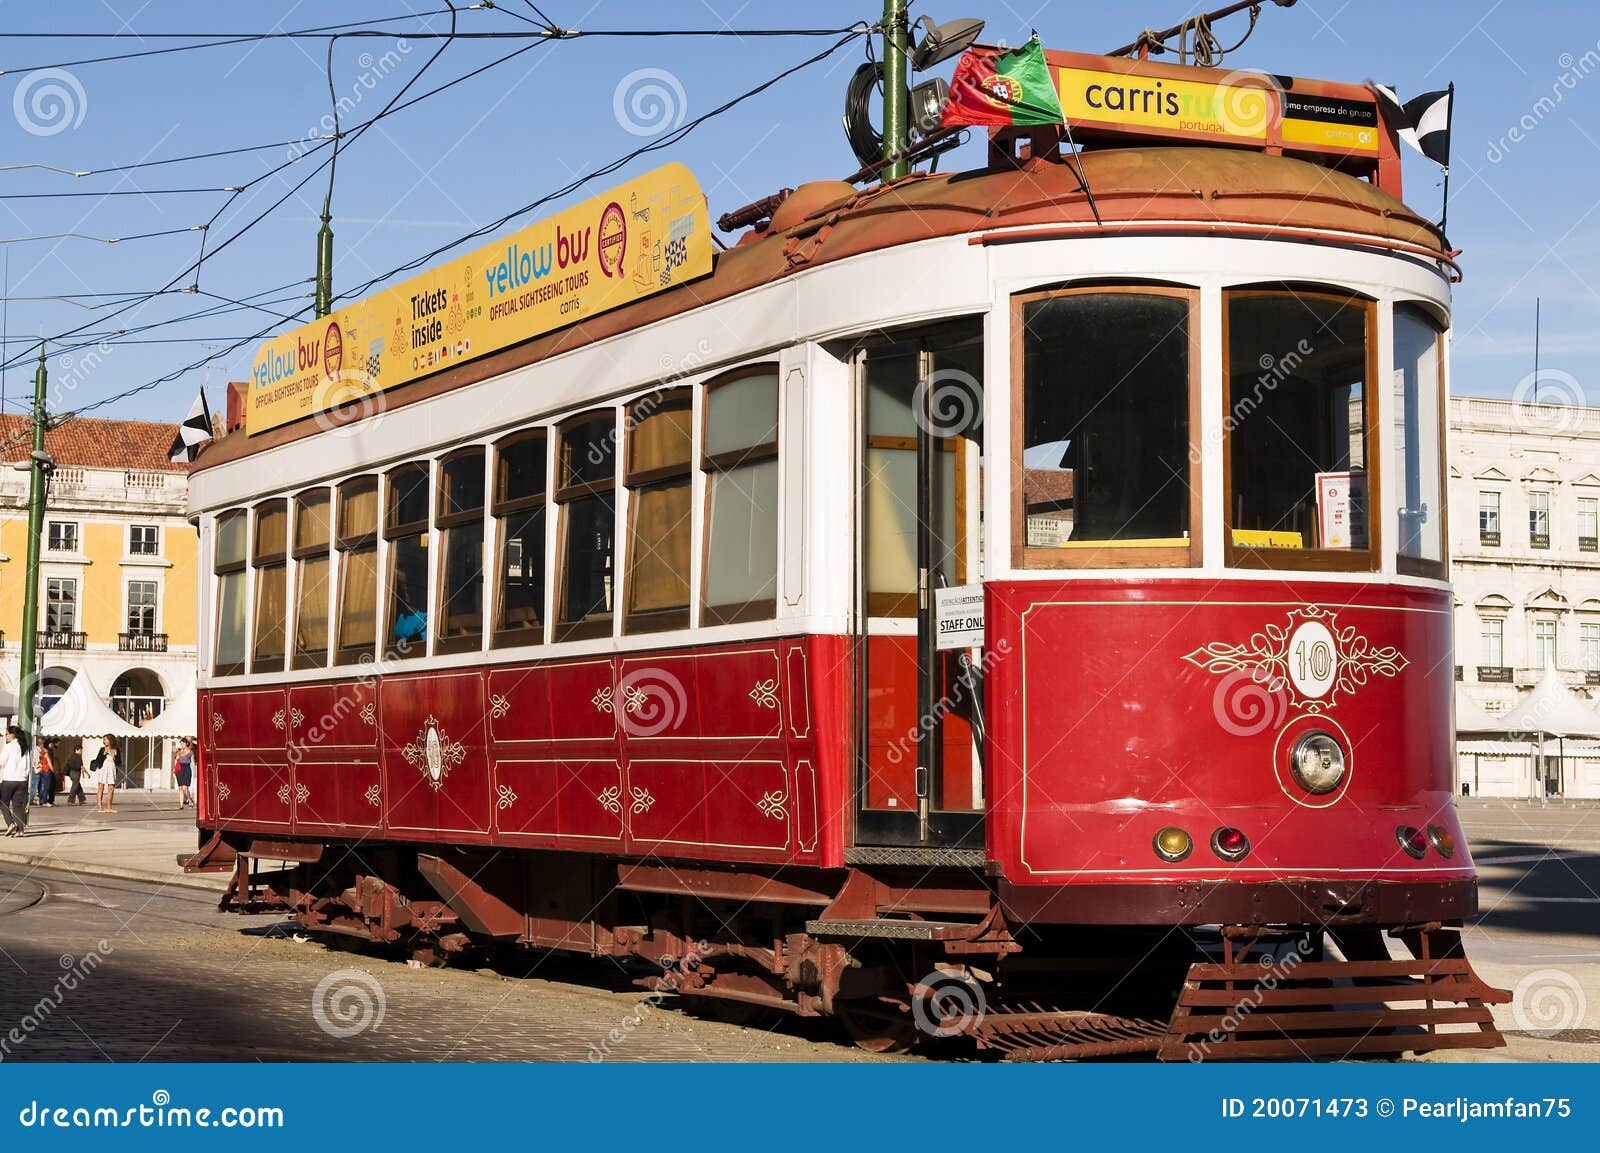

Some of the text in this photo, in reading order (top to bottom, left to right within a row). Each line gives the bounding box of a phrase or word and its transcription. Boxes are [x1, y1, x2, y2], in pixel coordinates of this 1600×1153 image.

[1303, 104, 1336, 115] empresa
[486, 243, 552, 298] yellow
[557, 225, 591, 269] bus
[411, 288, 447, 320] Tickets
[490, 299, 518, 321] OFFICIAL
[520, 280, 563, 311] SIGHTSEEING
[566, 270, 589, 294] TOURS
[411, 316, 442, 349] inside
[253, 336, 320, 390] yellow bus
[255, 374, 319, 409] OFFICIAL SIGHTSEEING TOURS
[940, 616, 984, 631] STAFF ONL
[1296, 641, 1333, 681] 10
